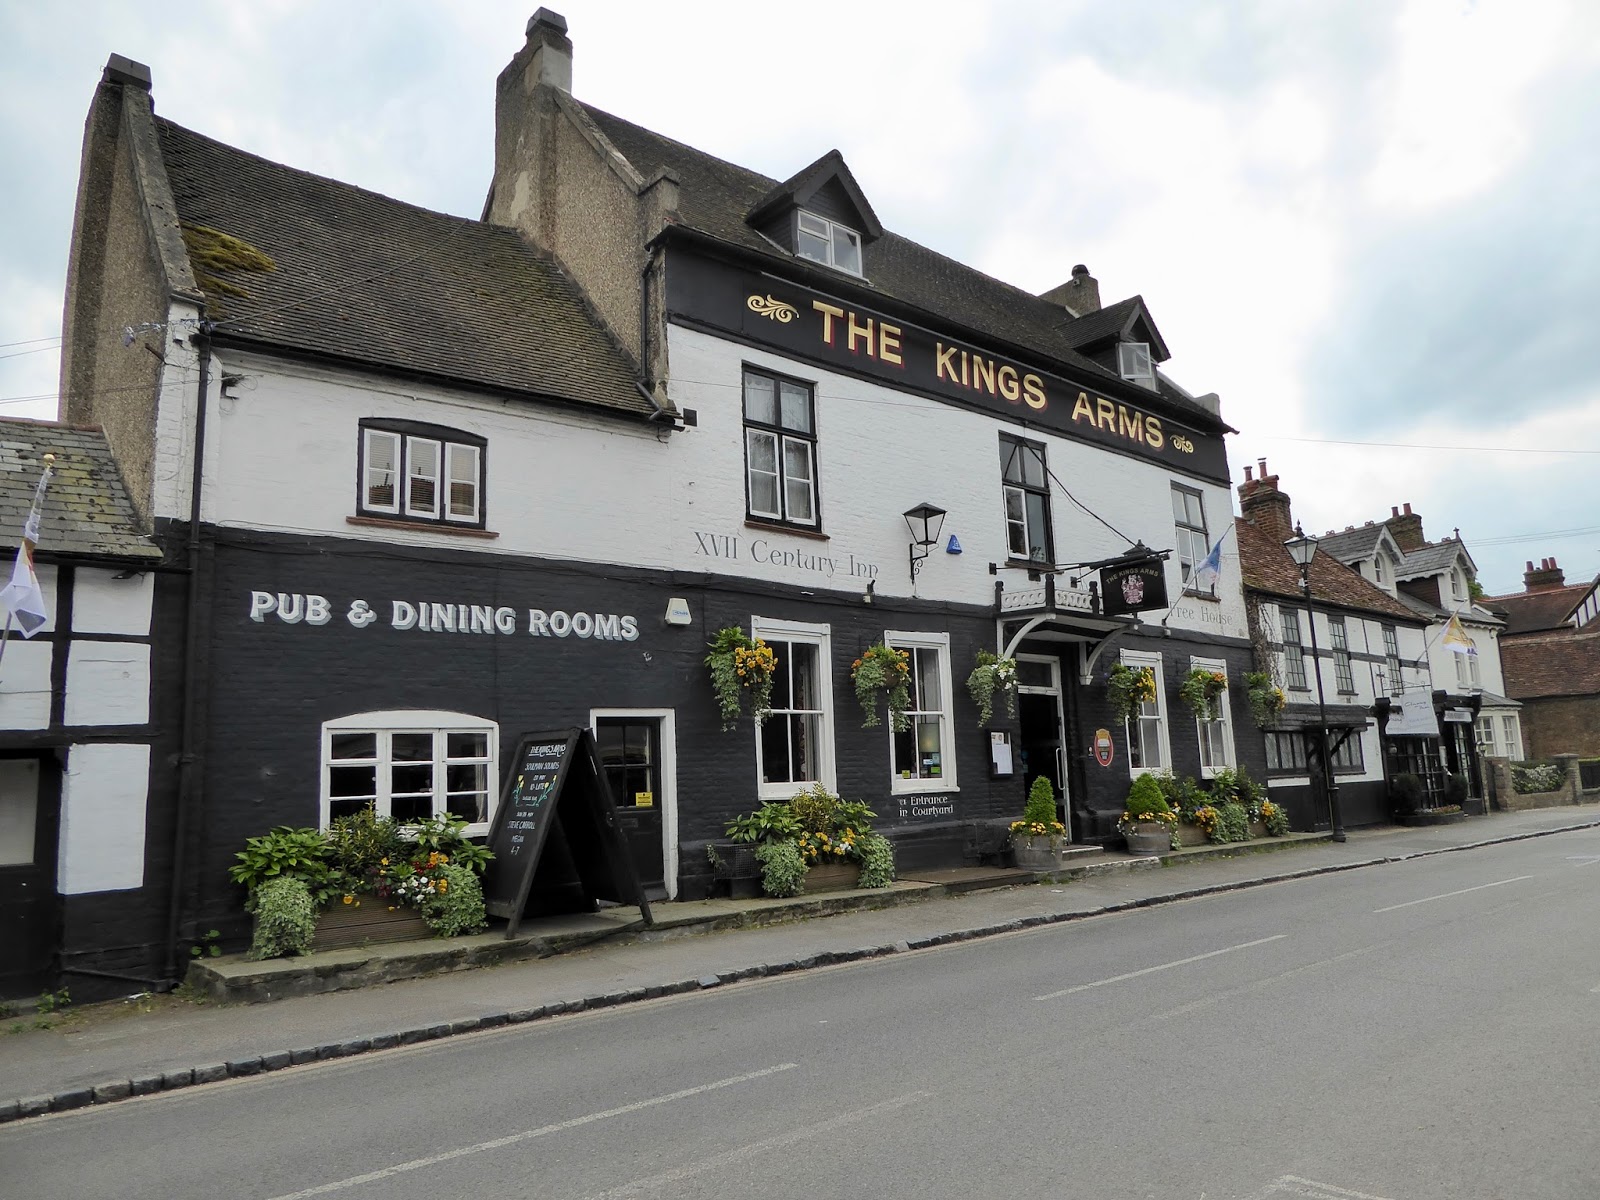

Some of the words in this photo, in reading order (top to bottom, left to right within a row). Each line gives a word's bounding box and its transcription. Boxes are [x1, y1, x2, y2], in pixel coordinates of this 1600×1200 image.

[812, 300, 903, 367] THE
[936, 342, 1048, 410] KINGS
[1071, 391, 1165, 449] ARMS
[693, 531, 738, 560] XVII
[750, 539, 839, 578] Century
[849, 554, 880, 580] Inn
[1106, 574, 1118, 584] THE
[1119, 567, 1139, 577] KINGS
[1139, 567, 1159, 577] ARMS
[250, 590, 332, 625] PUB
[346, 599, 378, 629] &
[391, 600, 517, 636] DINING
[528, 608, 640, 642] ROOMS
[1200, 605, 1233, 626] House
[899, 807, 908, 817] in
[912, 804, 954, 817] Courtyard
[910, 795, 948, 806] Entrance
